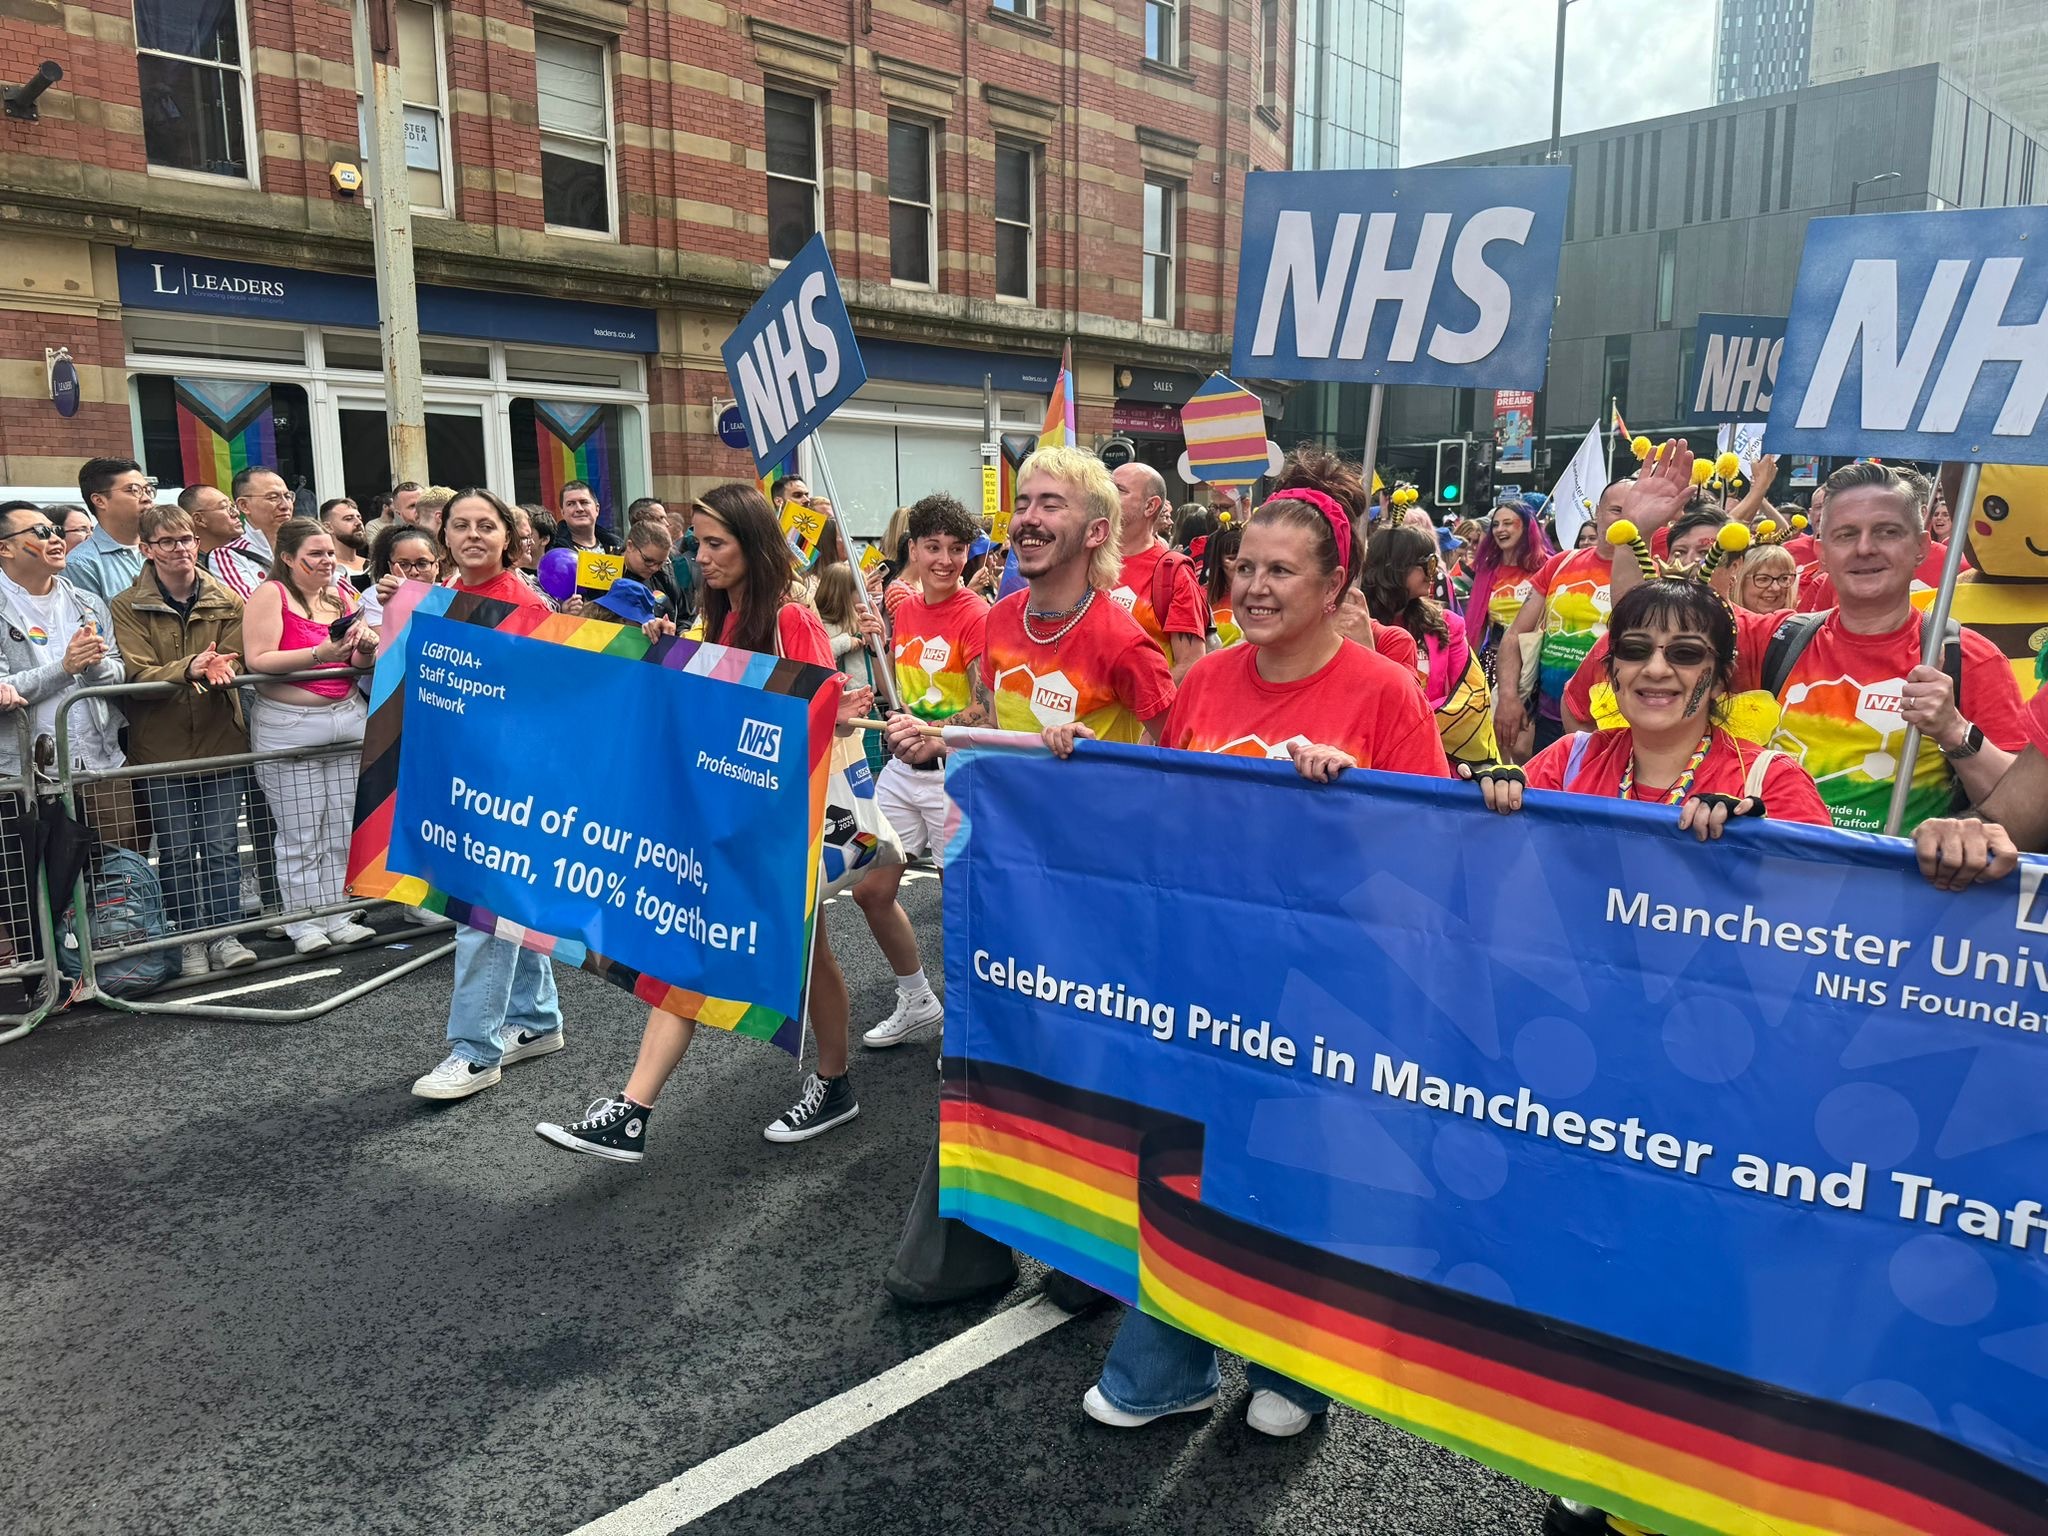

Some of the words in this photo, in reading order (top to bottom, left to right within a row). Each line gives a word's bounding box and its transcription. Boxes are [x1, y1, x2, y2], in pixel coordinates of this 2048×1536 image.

[151, 263, 180, 294] L
[191, 273, 285, 297] LEADERS
[1252, 206, 1535, 364] NHS
[593, 327, 636, 339] leaders.co.uk
[1795, 256, 2048, 437] NH
[737, 271, 841, 458] NHS
[1022, 374, 1048, 383] leaders.co.uk
[1694, 333, 1785, 413] NHS
[1153, 381, 1173, 392] SALES
[1497, 396, 1533, 406] DREAMS
[422, 640, 482, 669] LGBTQIA+
[924, 649, 945, 661] NHS
[420, 664, 445, 684] Staff
[447, 672, 506, 700] Support
[419, 687, 466, 715] Network
[1036, 689, 1071, 711] NHS
[1866, 694, 1902, 713] NH
[739, 721, 780, 758] NHS
[696, 750, 779, 790] Professionals
[857, 767, 869, 778] NHS
[839, 820, 855, 831] 2024
[1833, 817, 1880, 829] Trafford
[1855, 806, 1867, 816] In
[451, 777, 534, 827] Proud
[540, 806, 578, 838] of
[582, 821, 632, 854] our
[634, 837, 708, 894] people,
[421, 819, 456, 853] one
[463, 832, 538, 885] team,
[553, 857, 627, 908] 100%
[634, 886, 758, 955] together!
[1605, 887, 1911, 968] Manchester
[1814, 971, 1888, 1006] NHS
[973, 949, 1176, 1040] Celebrating
[1187, 1004, 1297, 1067] Pride
[1311, 1036, 1357, 1084] in
[1371, 1054, 1712, 1175] Manchester
[1731, 1152, 1867, 1211] and
